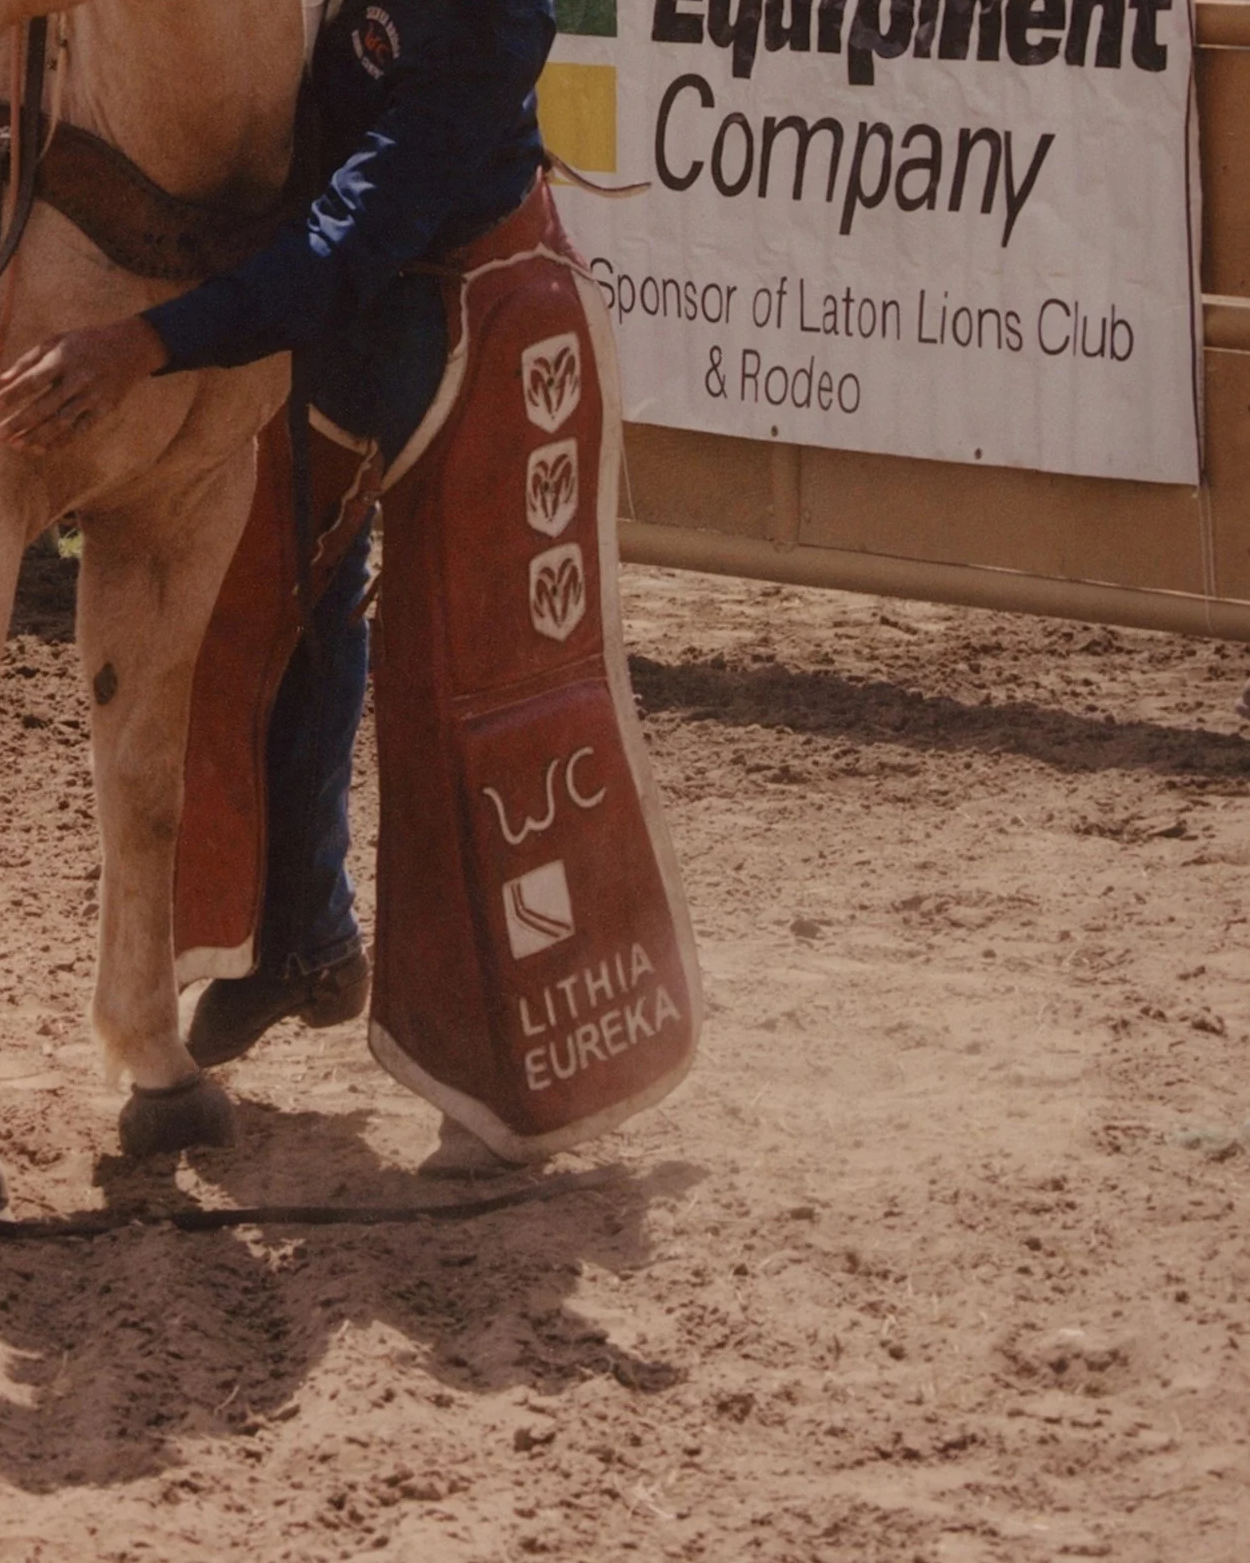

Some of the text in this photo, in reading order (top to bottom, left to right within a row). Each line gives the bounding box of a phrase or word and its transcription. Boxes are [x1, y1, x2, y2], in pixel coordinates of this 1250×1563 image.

[654, 73, 1055, 248] Company
[590, 257, 1134, 362] Sponsor of Laton Lions Club
[705, 345, 861, 414] & Rodeo
[519, 941, 655, 1038] LITHIA
[524, 984, 682, 1091] EUREKA
